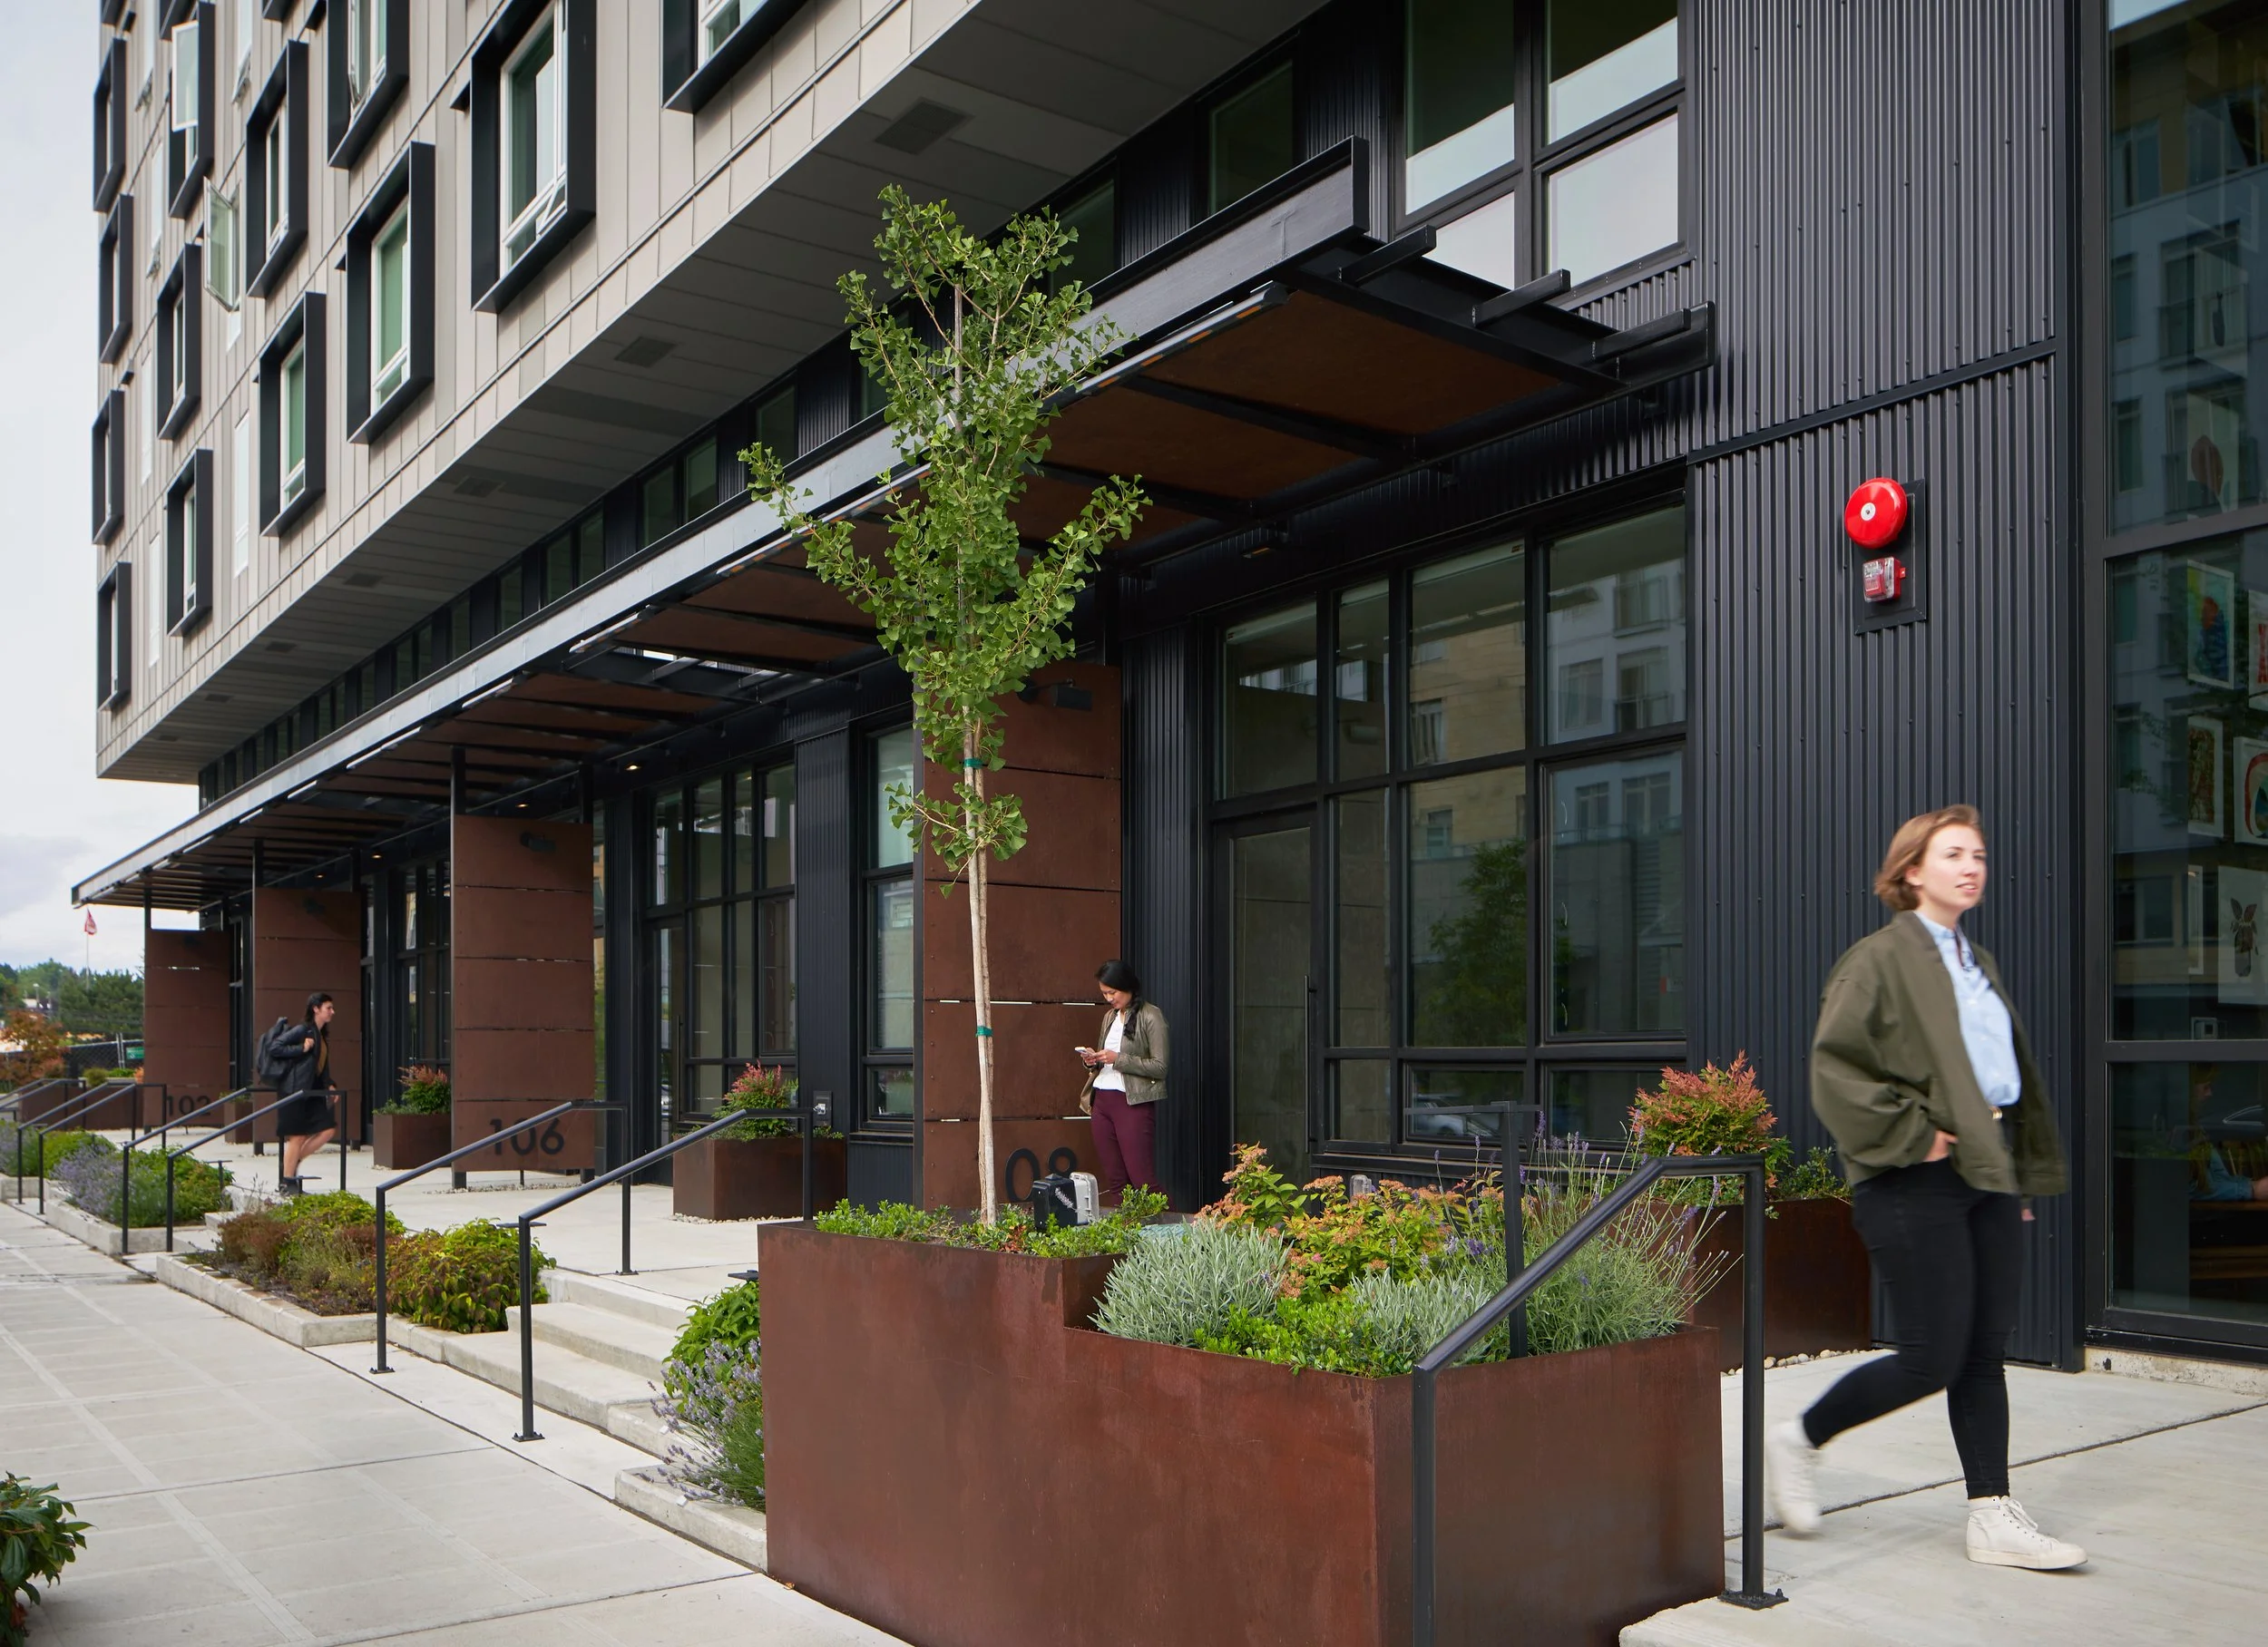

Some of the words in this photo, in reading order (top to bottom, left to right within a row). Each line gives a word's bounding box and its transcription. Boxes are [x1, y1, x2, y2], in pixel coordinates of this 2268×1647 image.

[166, 1095, 211, 1116] 102
[490, 1117, 564, 1155] 106
[976, 1147, 1077, 1202] 08
